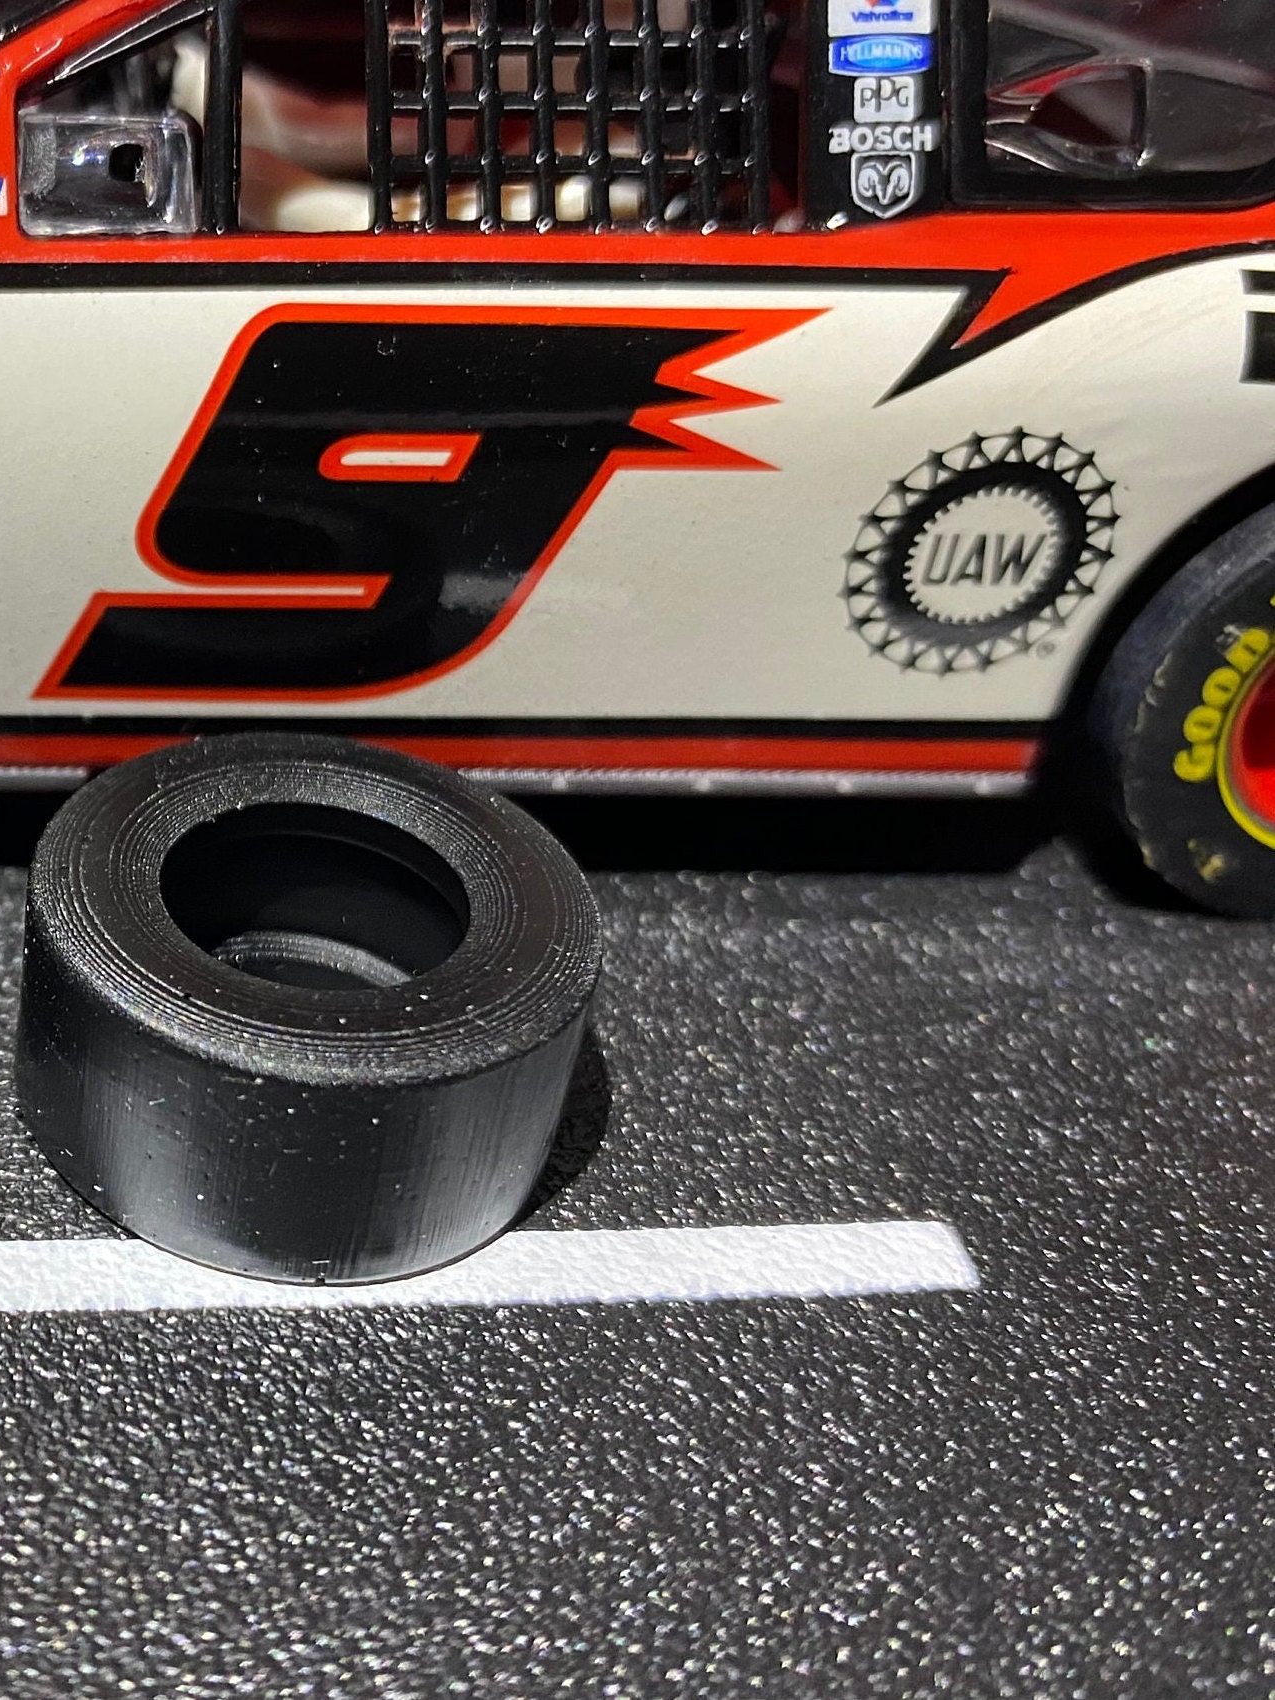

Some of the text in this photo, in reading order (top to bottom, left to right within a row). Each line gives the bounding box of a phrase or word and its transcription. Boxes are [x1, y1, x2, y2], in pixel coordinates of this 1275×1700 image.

[828, 125, 933, 154] BOSCH
[35, 303, 832, 701] 9
[921, 533, 1047, 586] UAW
